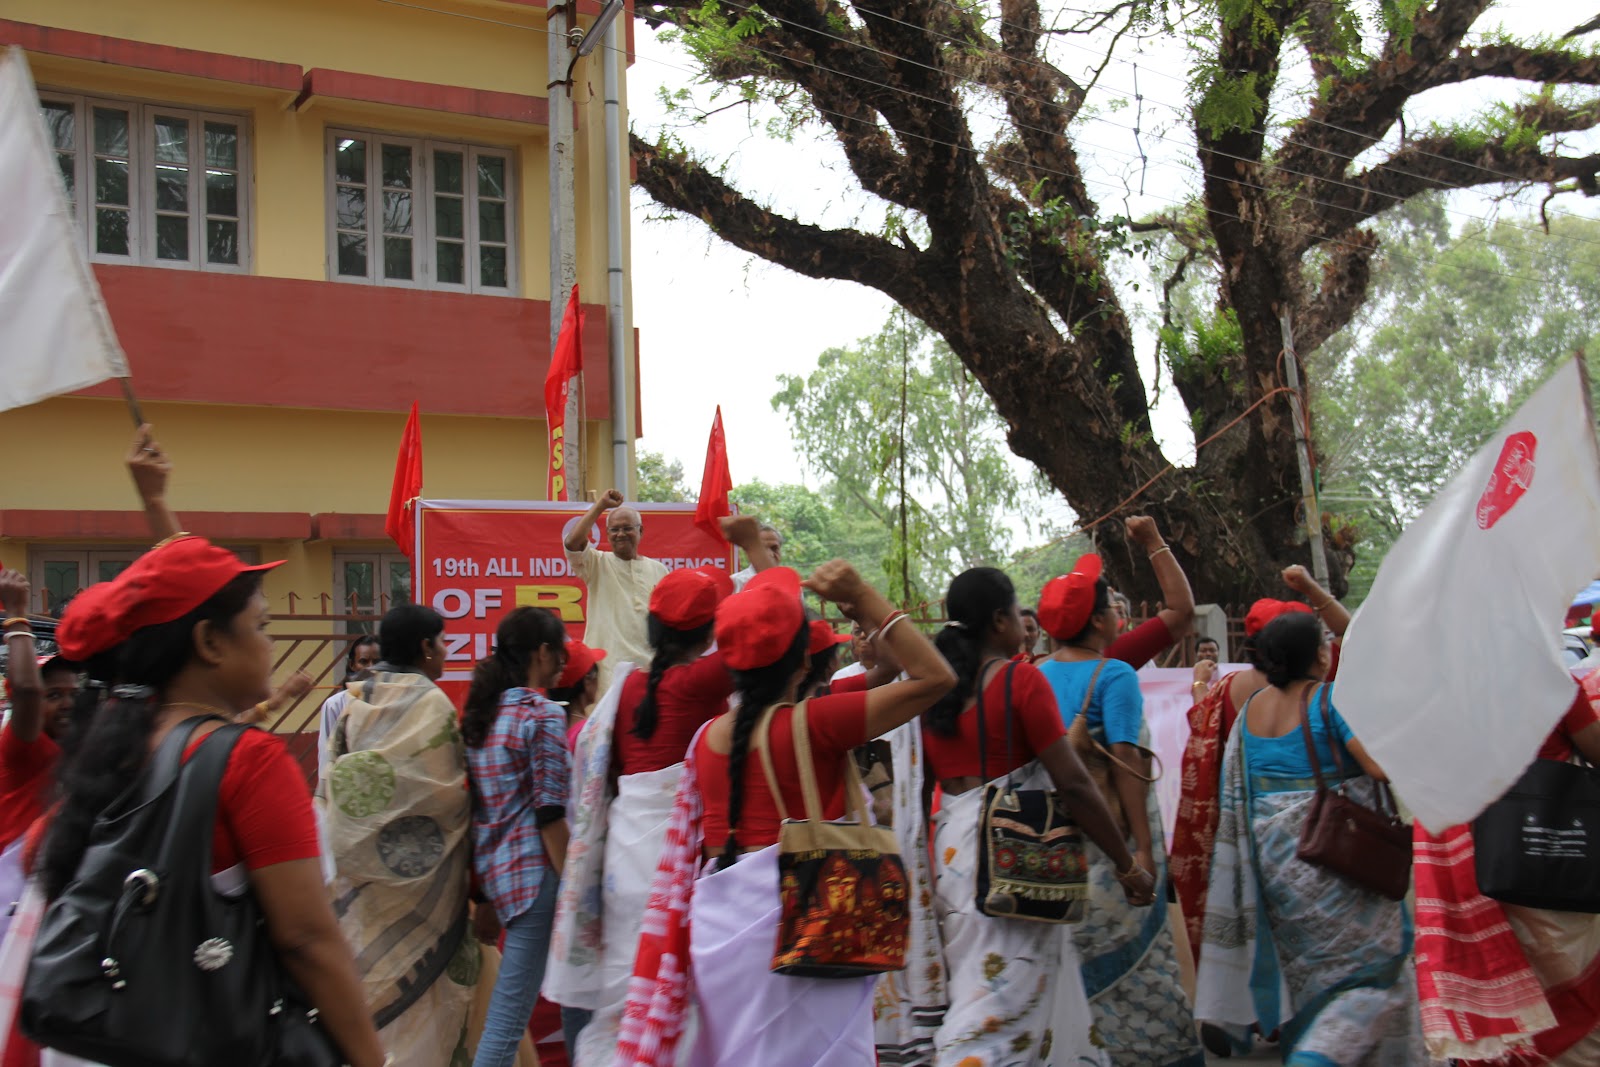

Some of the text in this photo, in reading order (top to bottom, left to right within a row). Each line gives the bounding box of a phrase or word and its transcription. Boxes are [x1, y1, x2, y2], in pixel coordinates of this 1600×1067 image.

[433, 558, 480, 577] 19th
[485, 558, 523, 577] ALL
[432, 588, 502, 618] OF
